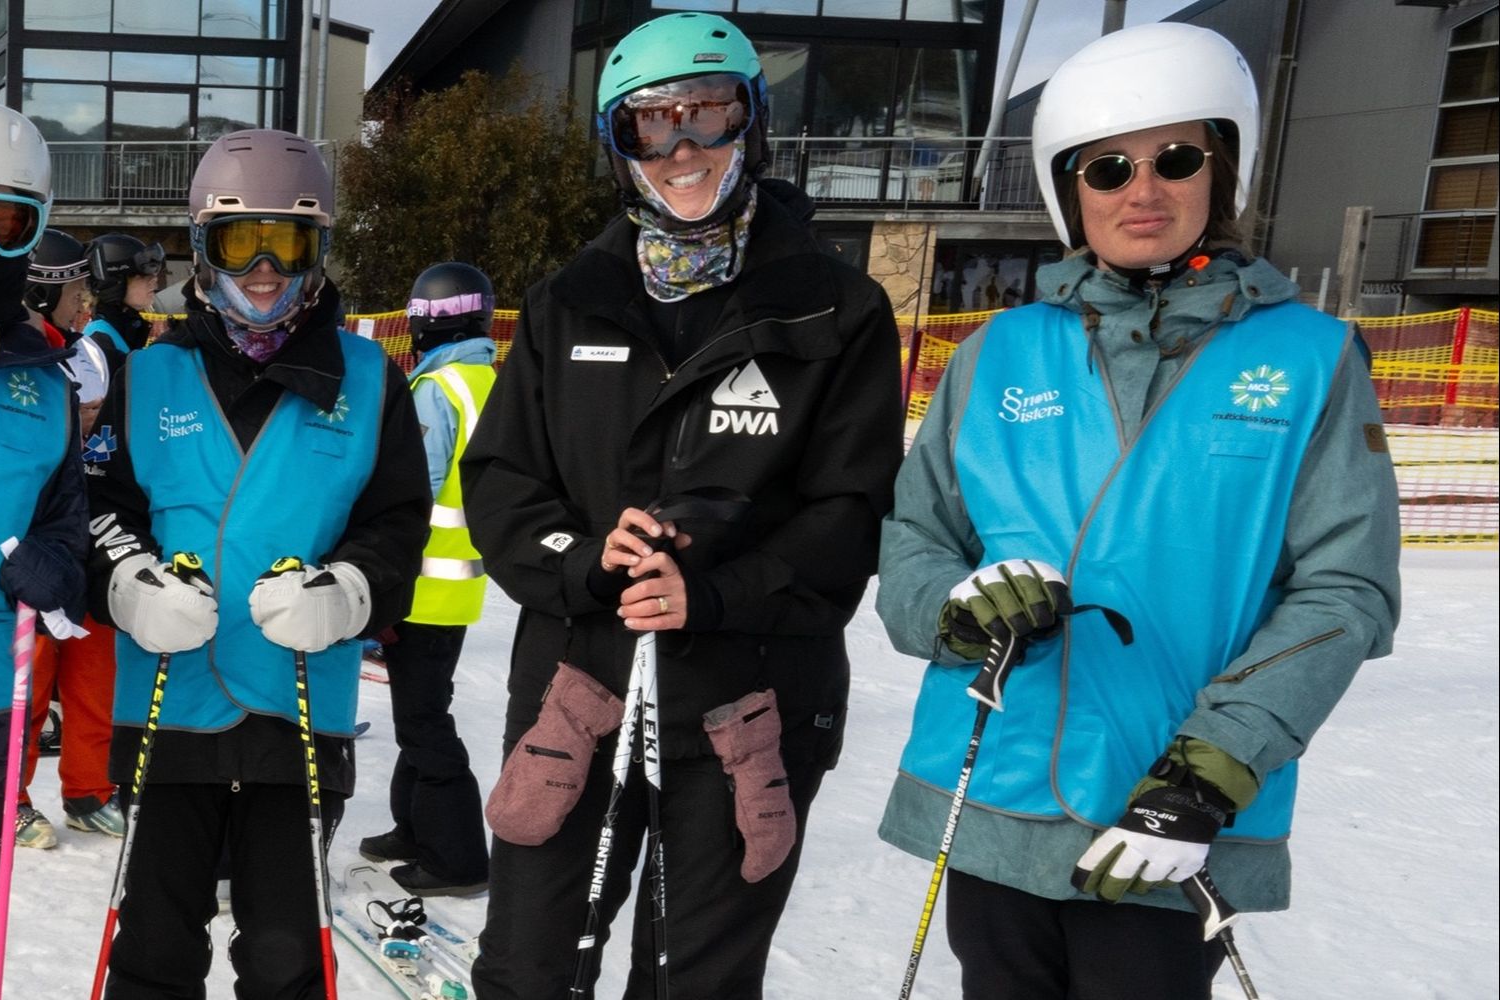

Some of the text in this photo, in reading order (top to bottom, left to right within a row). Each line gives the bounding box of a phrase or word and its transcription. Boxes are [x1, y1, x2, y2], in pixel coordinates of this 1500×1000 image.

[1003, 387, 1059, 411] Snow
[1246, 383, 1271, 392] MCS
[159, 407, 198, 430] Snow
[708, 409, 779, 436] DWA
[998, 398, 1065, 423] Sisters
[1260, 415, 1291, 426] sports
[159, 418, 204, 441] Sisters
[148, 671, 168, 731] LEKI
[644, 701, 658, 764] LEKI
[940, 767, 971, 853] KOMPERDELL
[1157, 812, 1179, 822] RIP
[588, 826, 612, 902] SENTINEL
